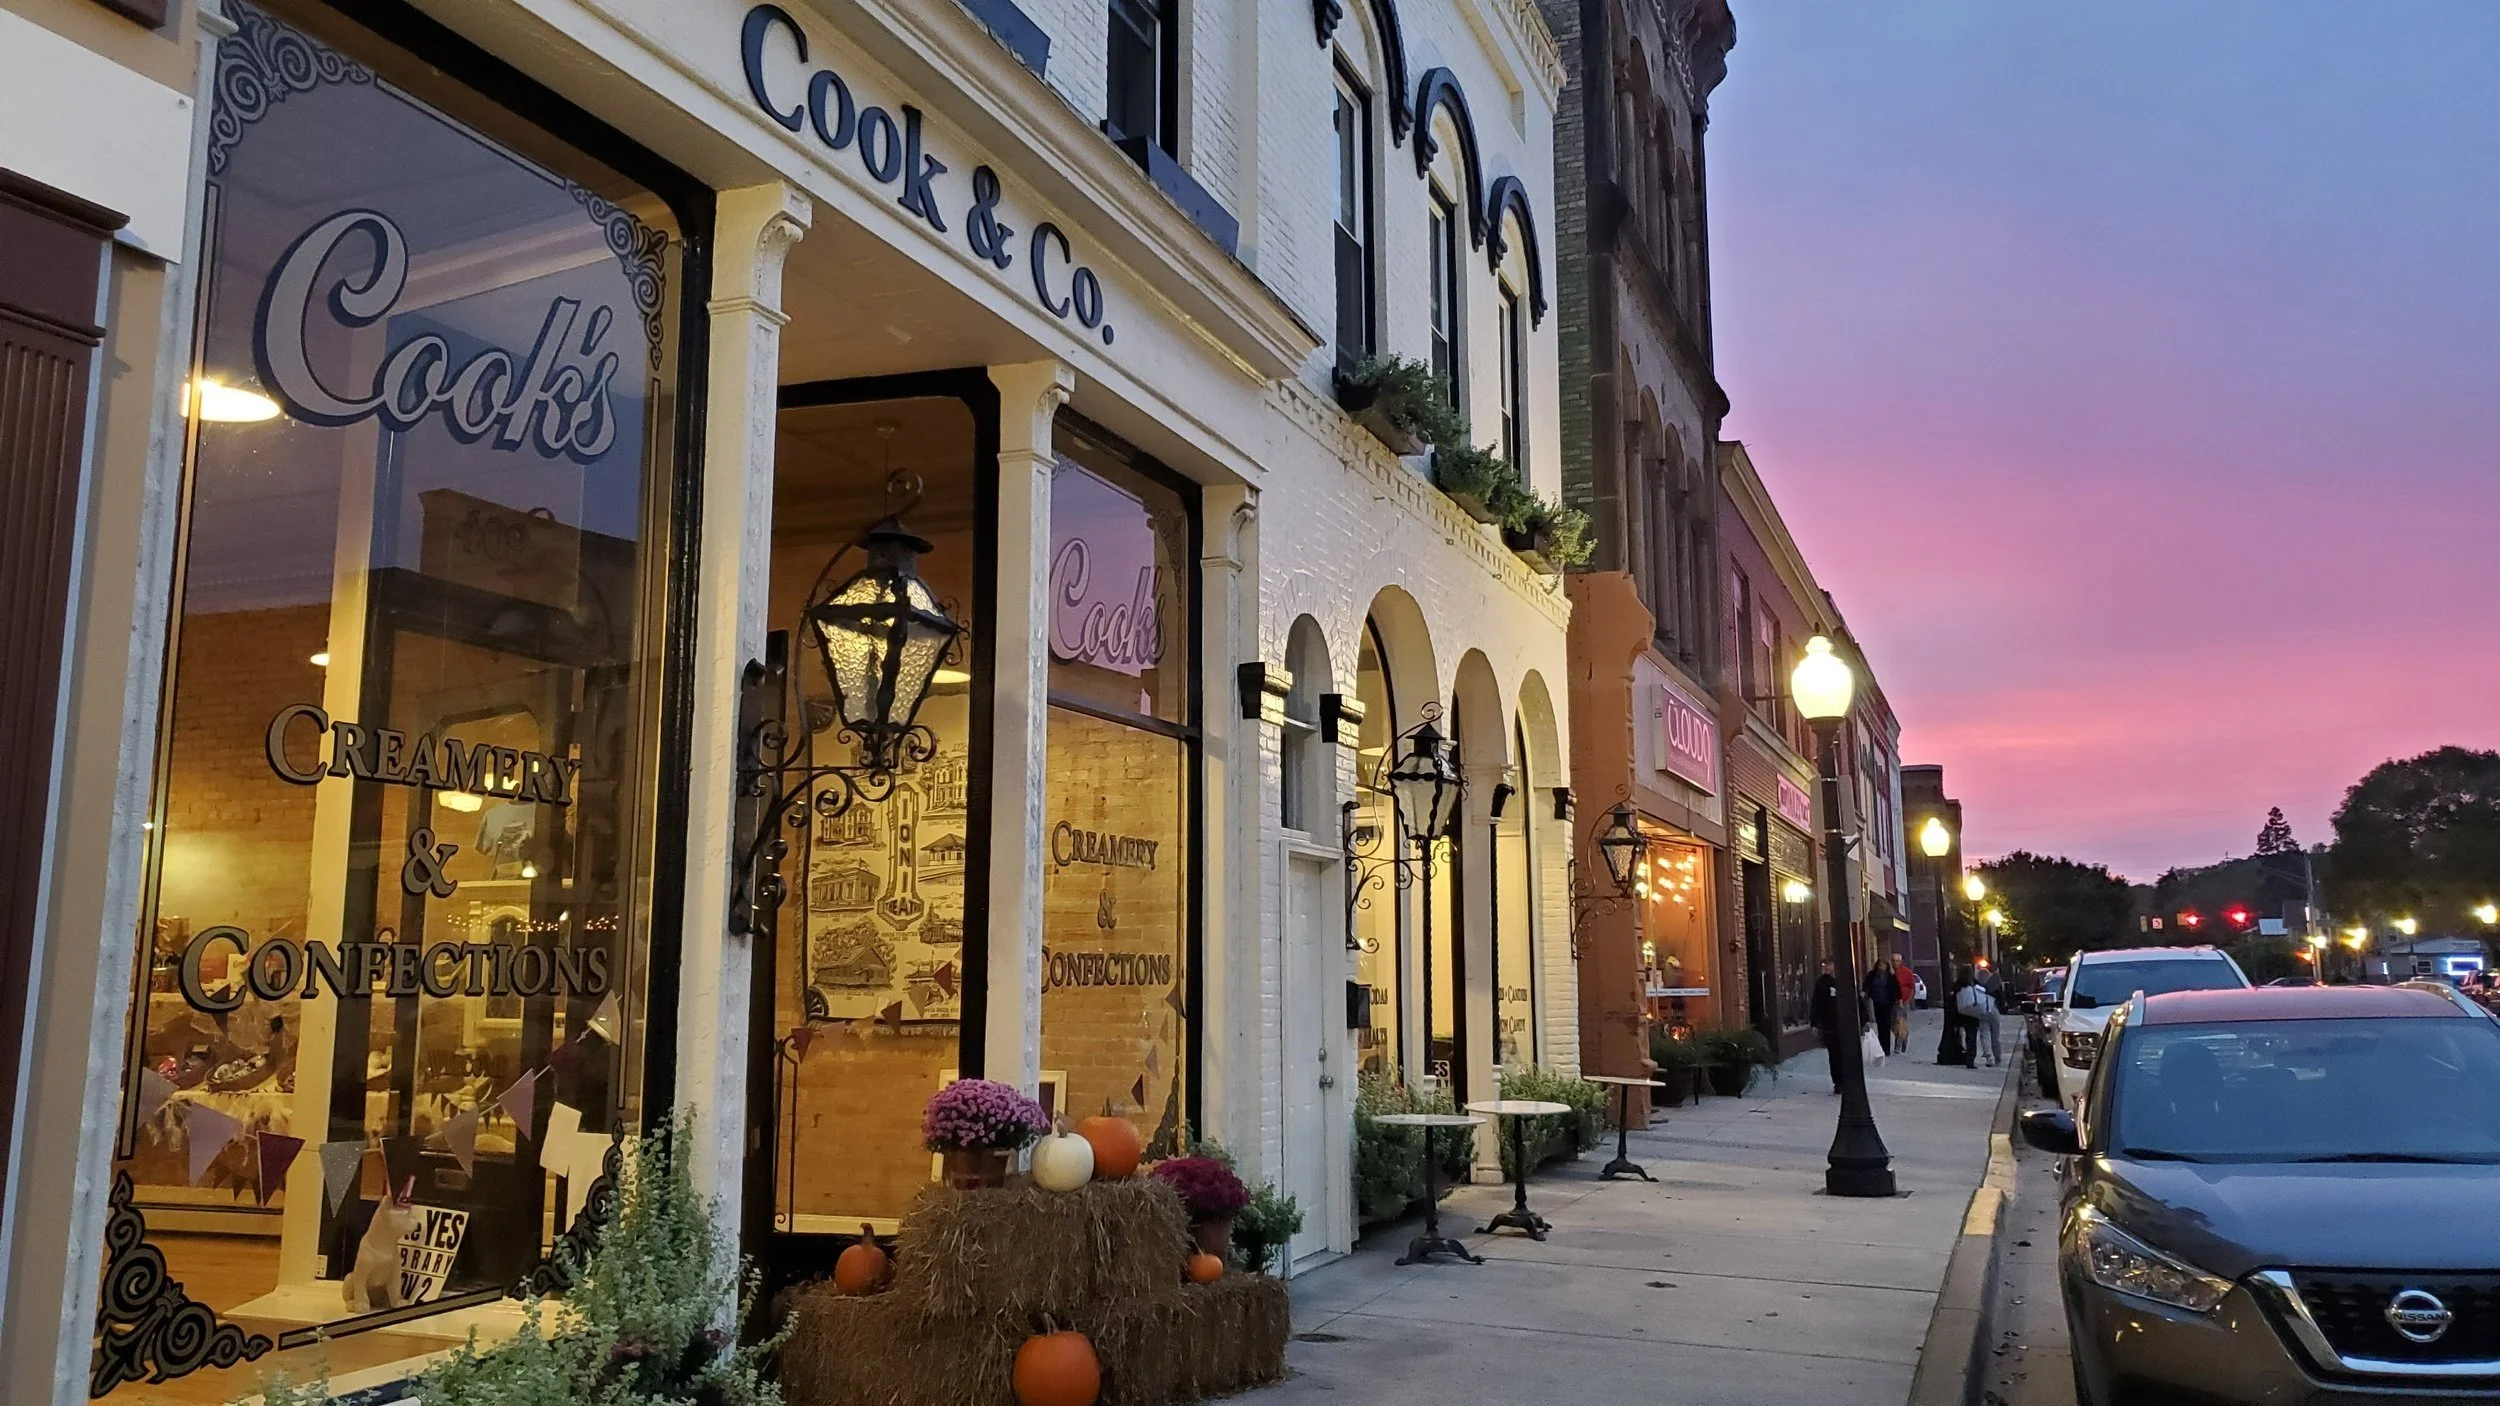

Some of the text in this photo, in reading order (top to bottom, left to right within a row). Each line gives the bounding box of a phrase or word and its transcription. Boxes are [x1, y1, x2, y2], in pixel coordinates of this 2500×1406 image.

[741, 4, 1114, 346] Cook & Co.
[252, 207, 619, 465] Cook's
[1048, 537, 1167, 666] Cook's
[266, 703, 582, 805] CREAMERY
[401, 827, 459, 898] &
[1052, 820, 1159, 870] CREAMERY
[1097, 888, 1117, 930] &
[178, 925, 609, 1014] CONFECTIONS
[1371, 988, 1388, 1005] ODAS
[1434, 1061, 1448, 1077] ES
[424, 1209, 465, 1250] YES
[400, 1271, 420, 1300] OV
[2392, 1313, 2445, 1321] NISSAN
